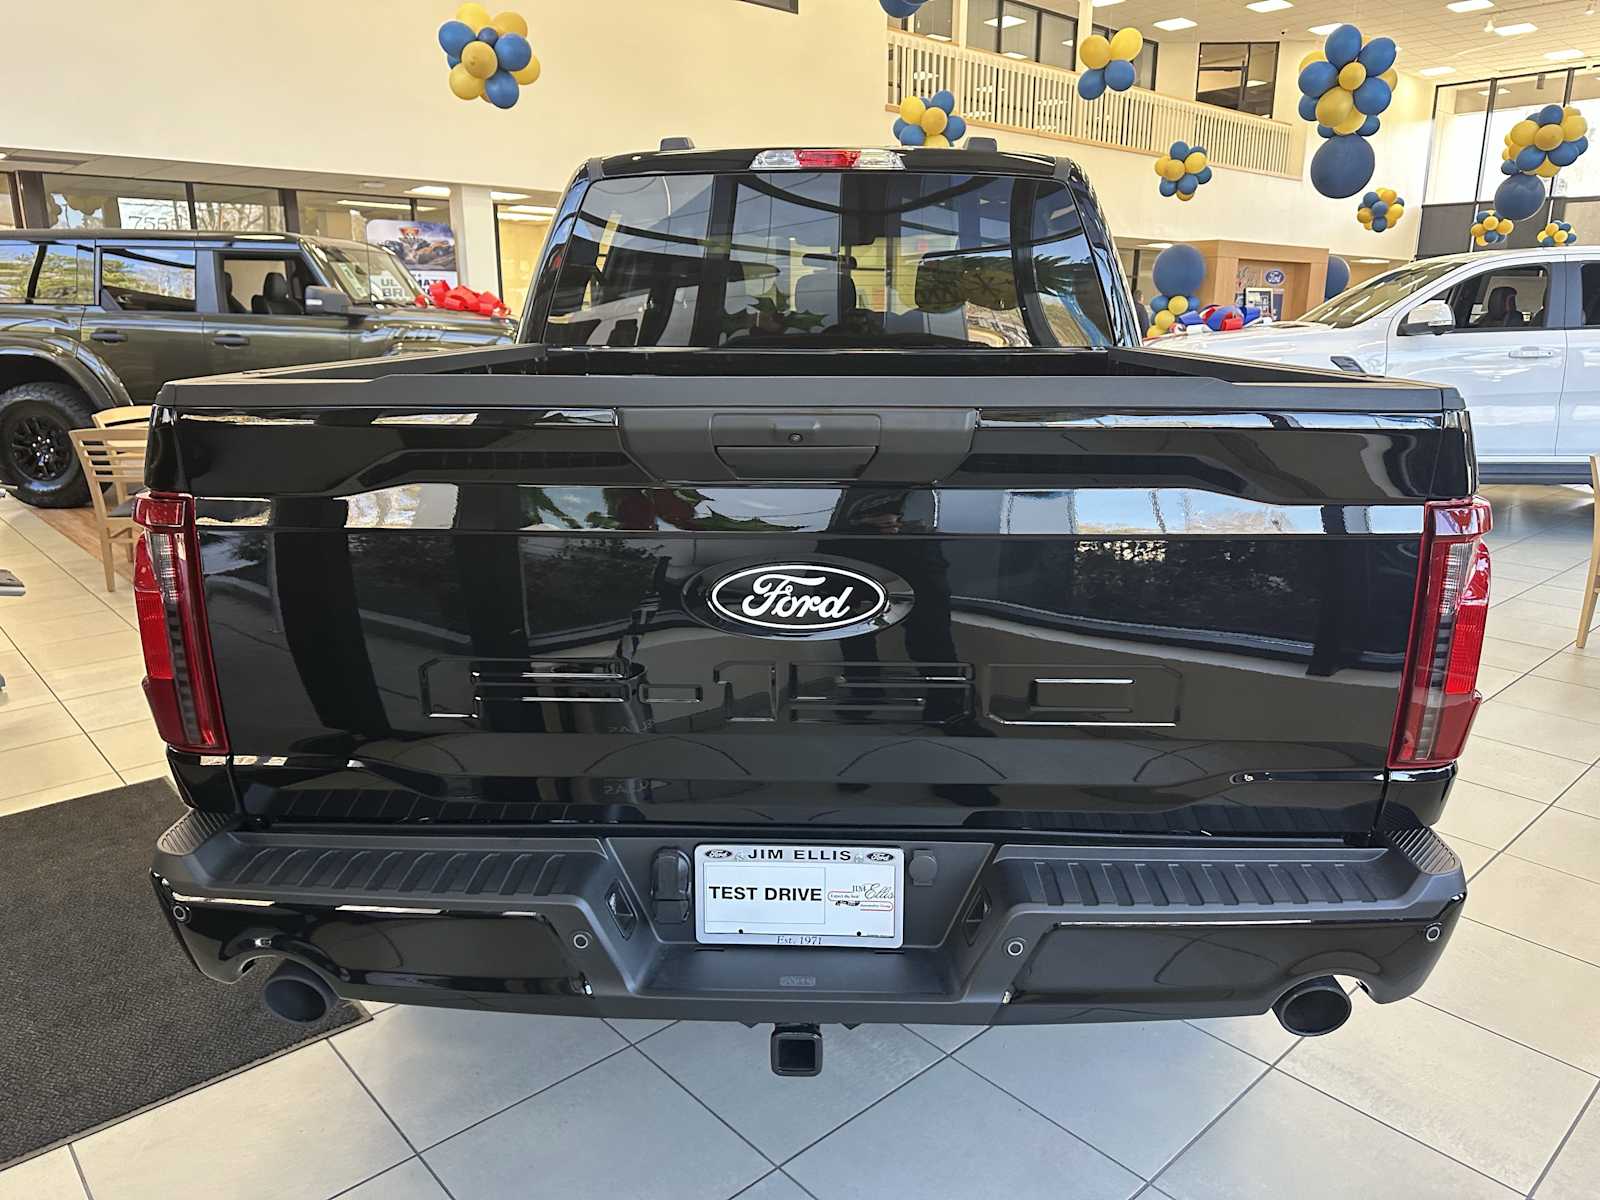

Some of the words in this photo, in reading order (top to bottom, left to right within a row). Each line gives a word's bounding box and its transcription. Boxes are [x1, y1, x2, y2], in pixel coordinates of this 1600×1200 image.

[742, 573, 853, 619] Ford
[419, 656, 1183, 727] F-150
[748, 849, 783, 860] JIM
[794, 850, 851, 861] ELLIS
[709, 886, 758, 900] TEST
[765, 887, 822, 901] DRIVE
[865, 883, 894, 899] Ellis
[799, 936, 822, 946] 1971
